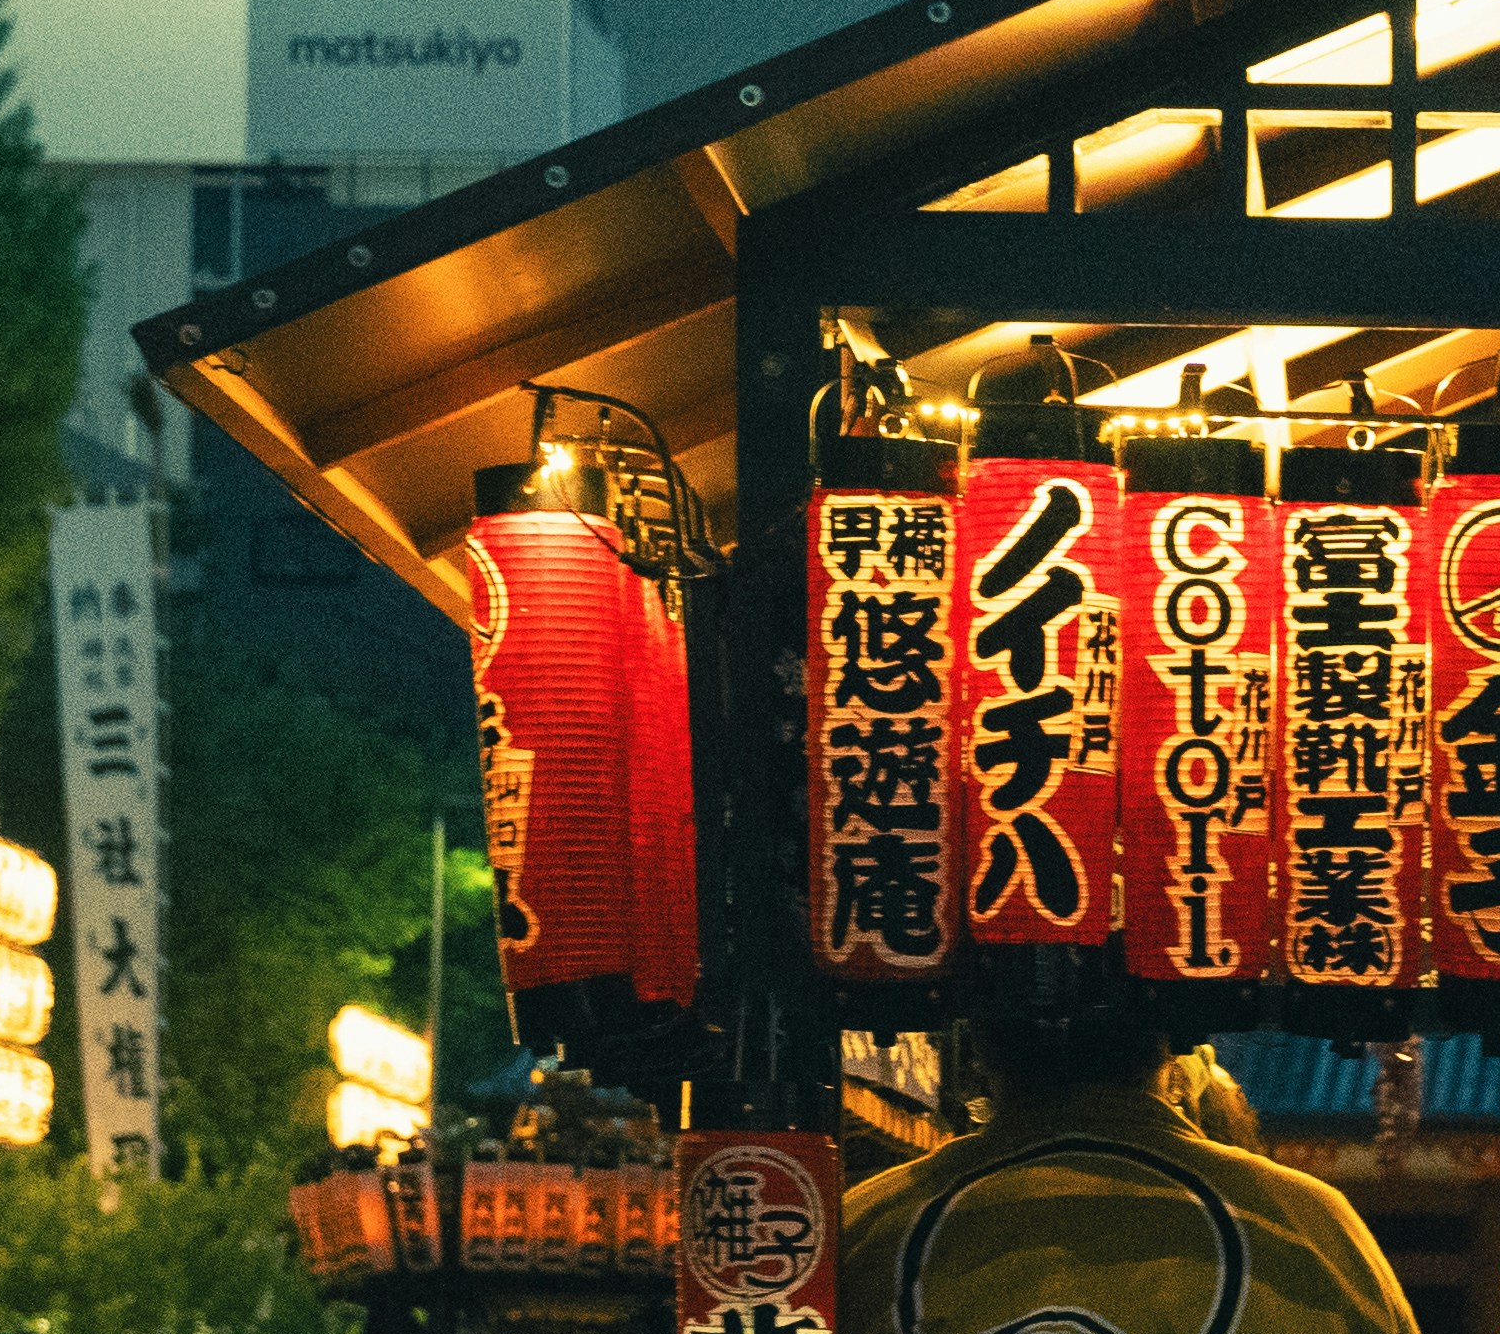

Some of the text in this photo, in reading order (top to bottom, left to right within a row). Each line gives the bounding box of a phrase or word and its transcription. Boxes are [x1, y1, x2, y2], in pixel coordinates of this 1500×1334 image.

[291, 28, 520, 74] matsukiyo
[830, 589, 944, 957] 悠遊庵
[974, 484, 1086, 920] ノイチハ
[1233, 668, 1271, 829] 花川戸
[1392, 658, 1428, 820] 花川戸
